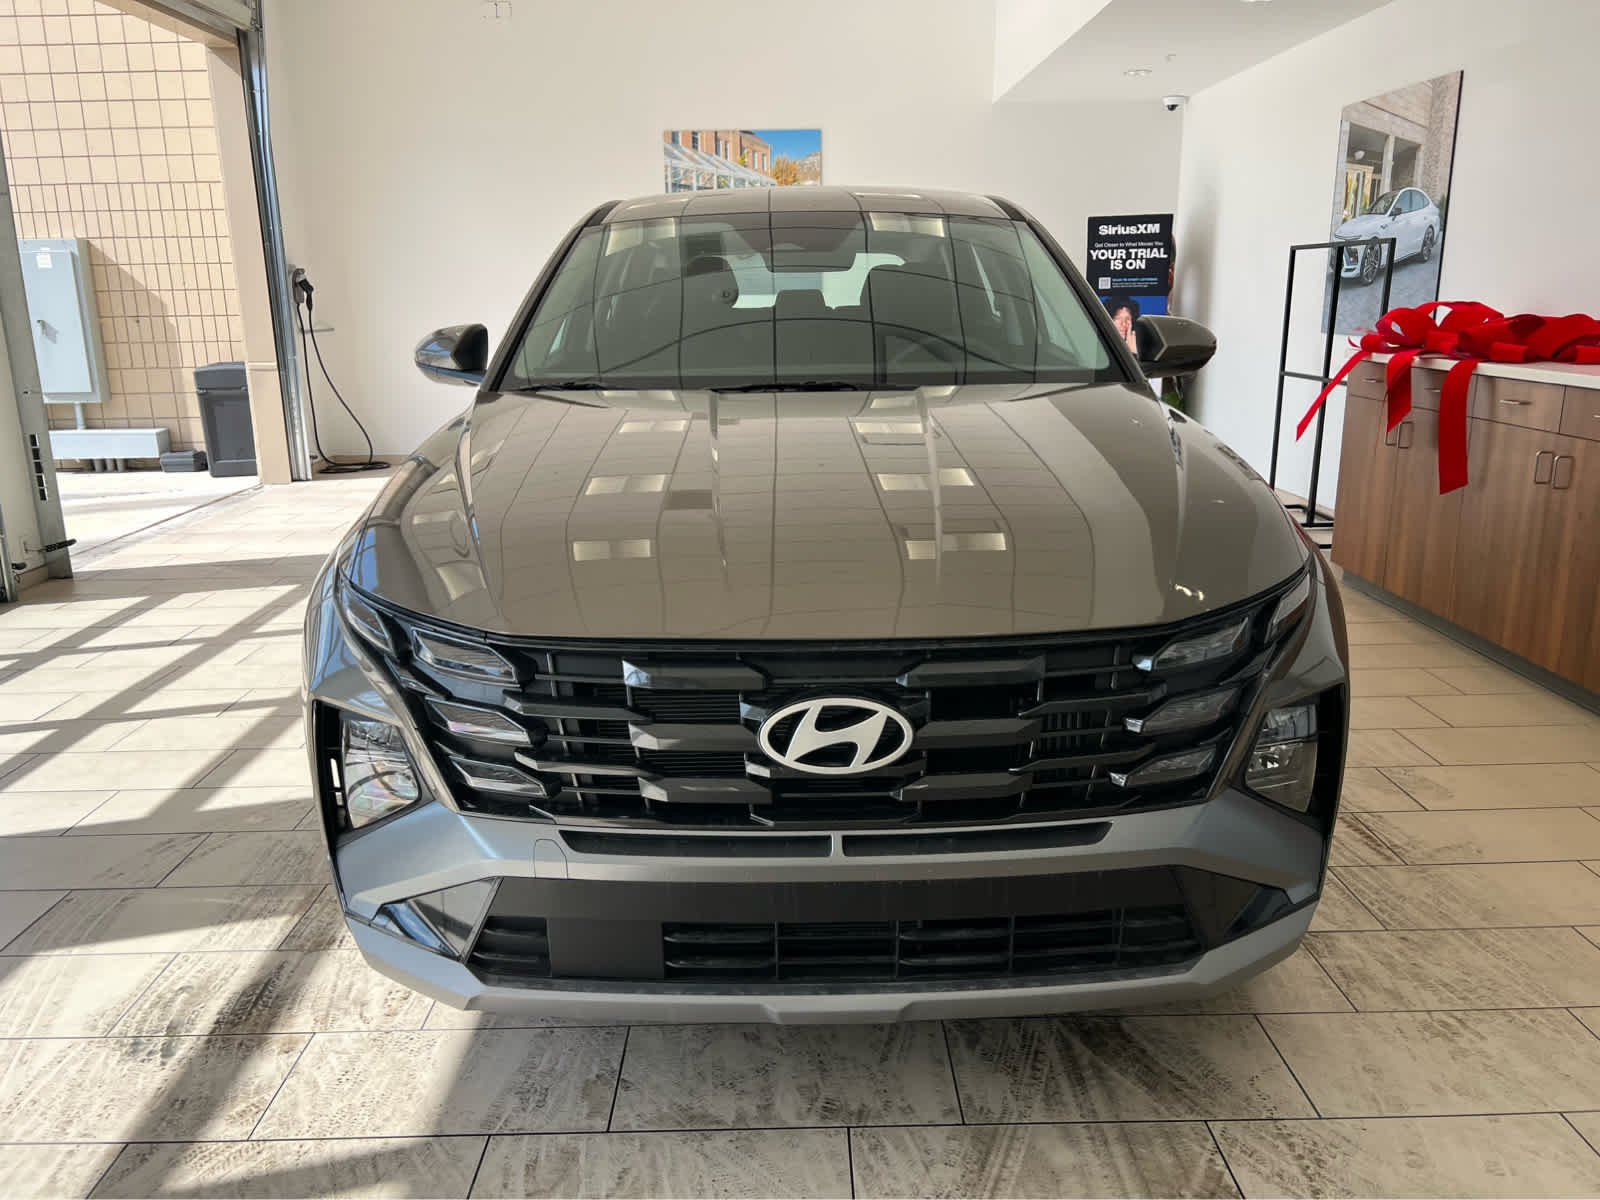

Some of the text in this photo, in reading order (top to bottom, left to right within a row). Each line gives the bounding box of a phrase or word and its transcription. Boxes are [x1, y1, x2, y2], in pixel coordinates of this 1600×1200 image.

[1098, 223, 1160, 235] SiriusXM
[1090, 248, 1167, 260] YOUR TRIAL
[1110, 259, 1146, 270] IS ON
